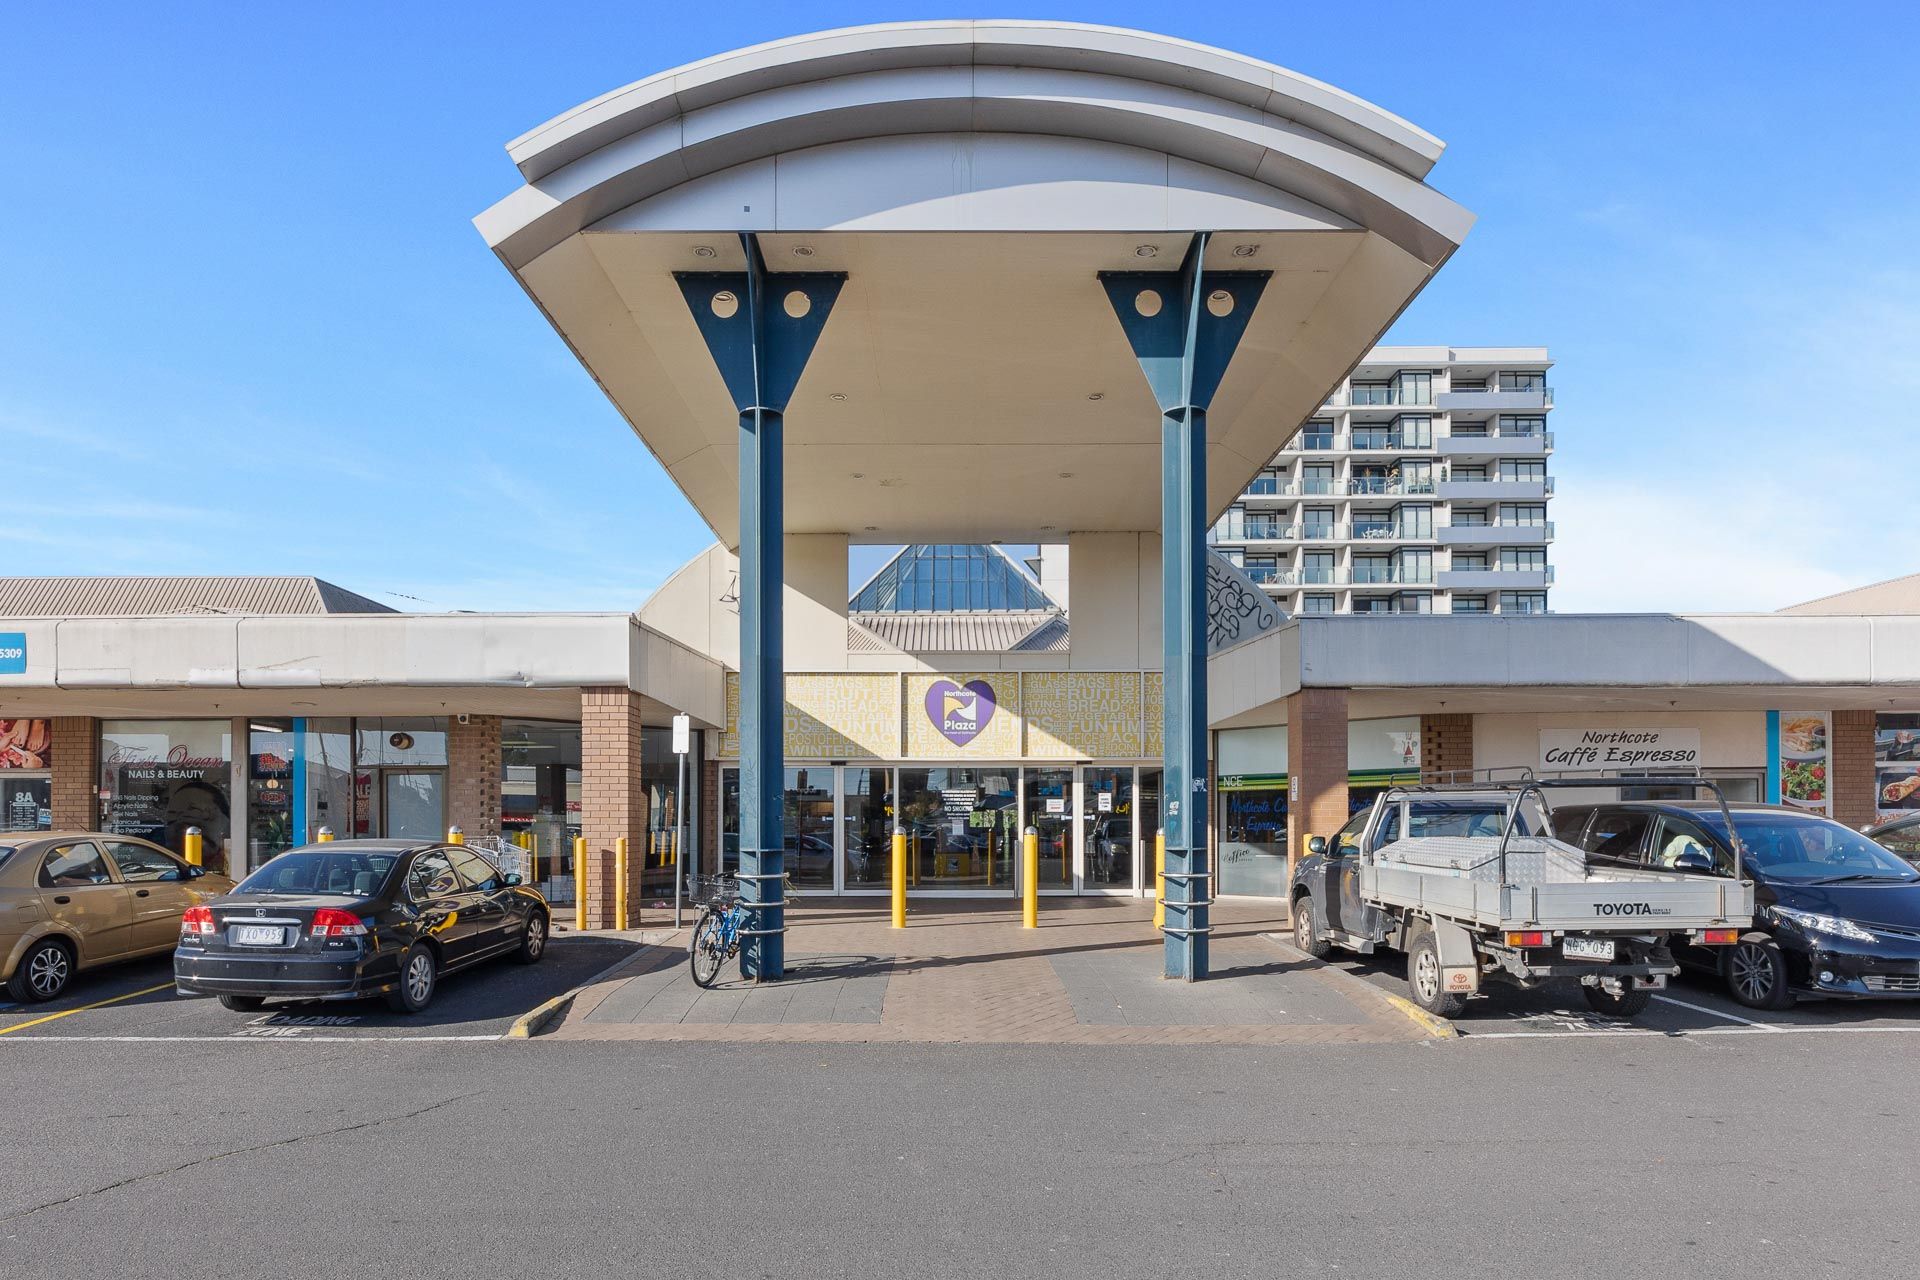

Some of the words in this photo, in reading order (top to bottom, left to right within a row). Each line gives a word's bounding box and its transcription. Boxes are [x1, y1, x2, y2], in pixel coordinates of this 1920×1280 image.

[1068, 700, 1120, 712] BREAD
[944, 720, 977, 730] Plaza
[1581, 731, 1659, 744] Northcote
[1545, 747, 1599, 766] Caffé
[1604, 747, 1696, 766] Espresso
[128, 770, 155, 779] NAILS
[157, 770, 165, 779] &
[167, 770, 204, 779] BEAUTY
[1223, 776, 1243, 787] NCE
[15, 792, 34, 802] 8A
[1593, 903, 1652, 916] TOYOTA
